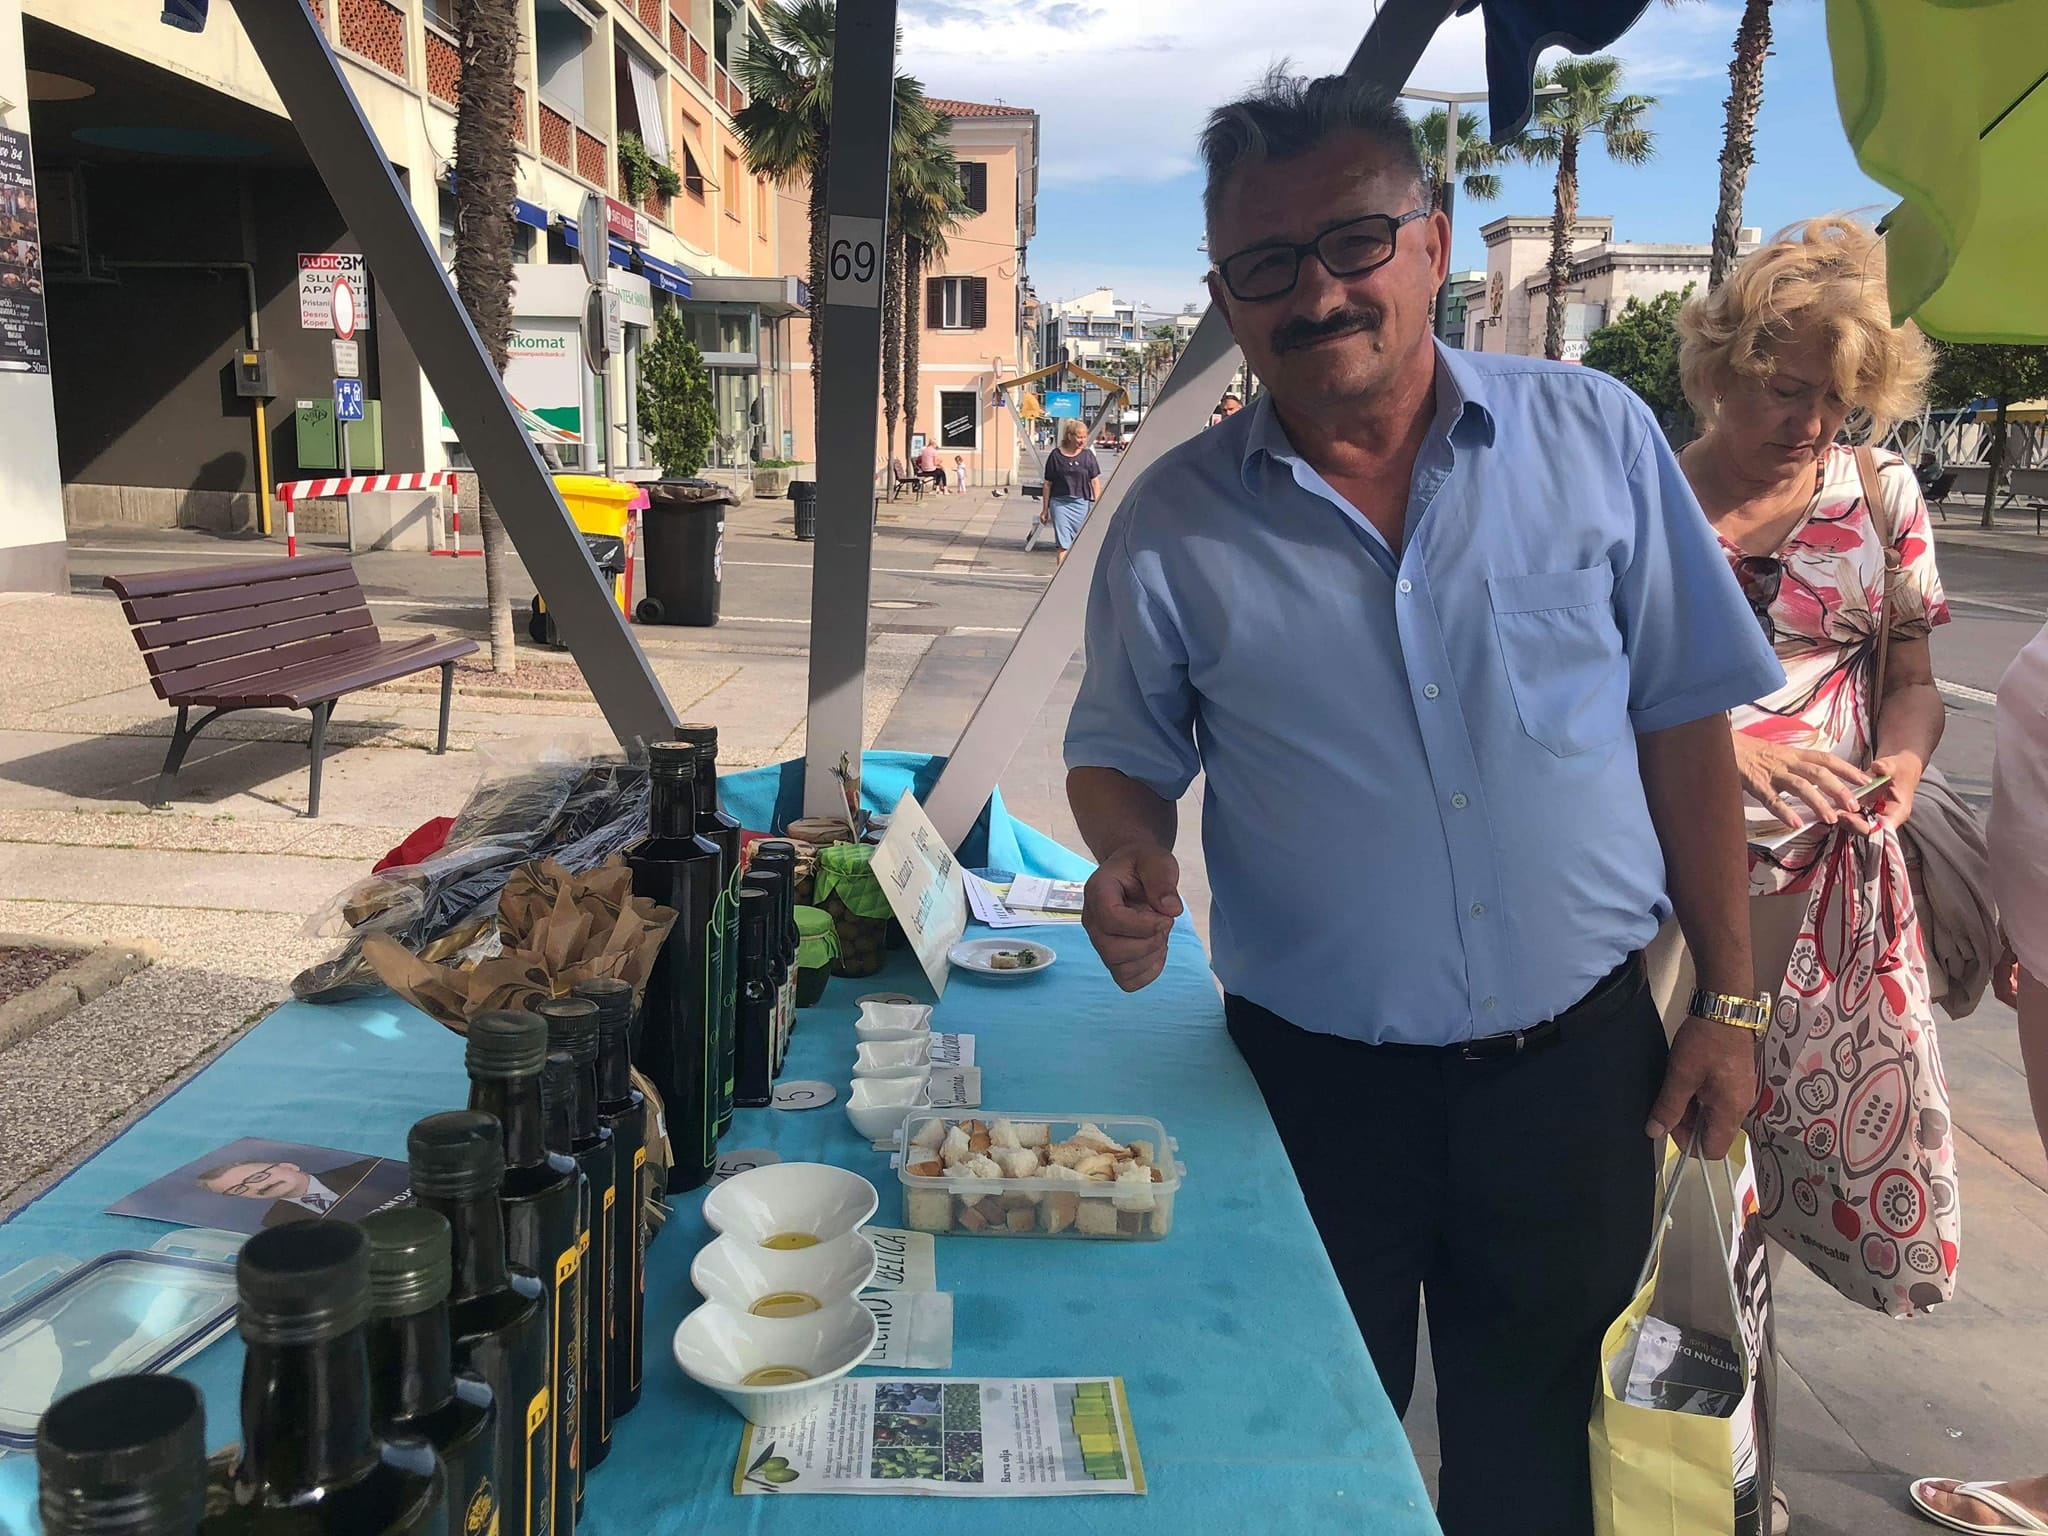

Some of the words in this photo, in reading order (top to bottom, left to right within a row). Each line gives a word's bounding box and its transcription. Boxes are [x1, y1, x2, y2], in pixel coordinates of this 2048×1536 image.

[830, 239, 875, 283] 69
[302, 286, 367, 295] APATI
[303, 319, 328, 327] Koper
[508, 335, 565, 348] nkomat
[776, 1091, 815, 1102] 5
[999, 1449, 1012, 1463] olja
[1001, 1464, 1011, 1483] Barva
